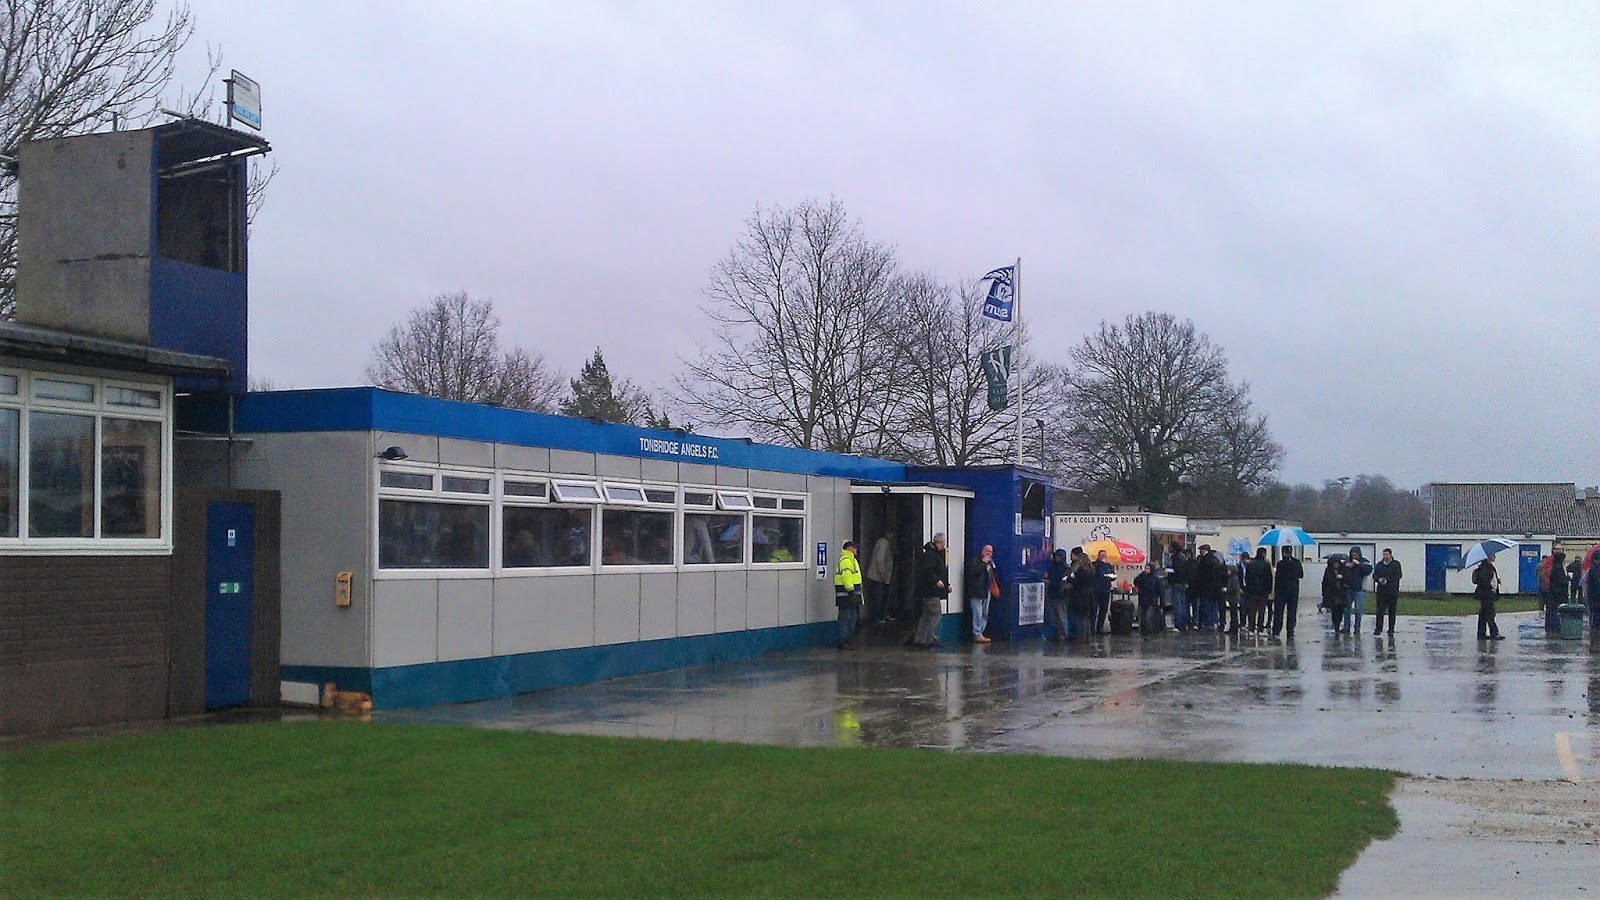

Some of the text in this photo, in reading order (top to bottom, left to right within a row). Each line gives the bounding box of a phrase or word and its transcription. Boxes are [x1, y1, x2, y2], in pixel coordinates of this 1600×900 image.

[639, 437, 719, 460] TONBRIDGE ANGELS F.C.
[1060, 516, 1072, 524] HOT
[1079, 516, 1096, 524] COLD
[1096, 516, 1113, 524] FOOD
[1121, 516, 1144, 524] DRINKS
